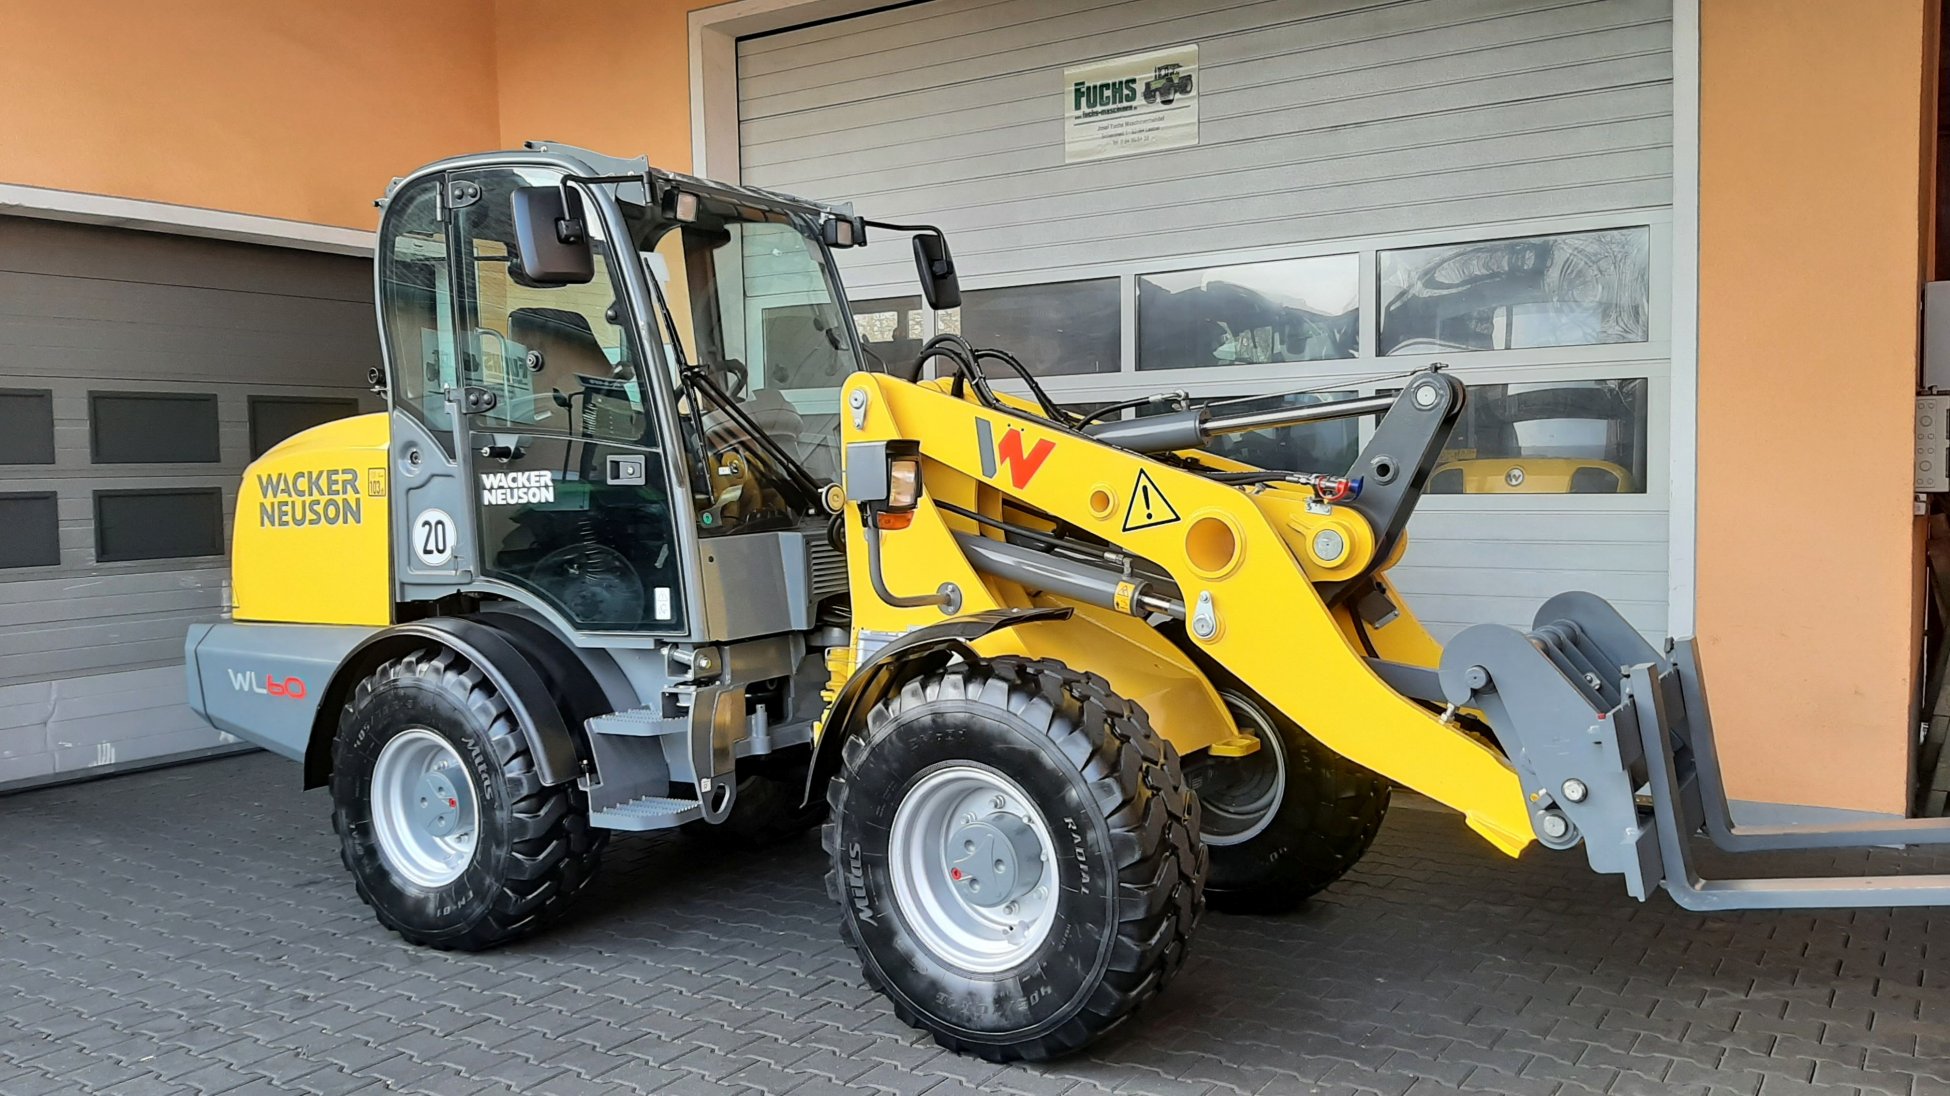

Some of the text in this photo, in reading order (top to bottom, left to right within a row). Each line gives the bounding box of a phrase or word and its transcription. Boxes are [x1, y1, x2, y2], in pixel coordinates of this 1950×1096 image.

[1074, 78, 1137, 111] FUCHS
[257, 468, 360, 498] WACKER
[481, 470, 554, 489] WACKER
[483, 486, 554, 506] NEUSON
[259, 498, 361, 527] NEUSON
[421, 520, 447, 555] 20
[461, 737, 494, 800] Mitas
[1064, 816, 1090, 896] RADIAL
[849, 842, 878, 927] Mitas
